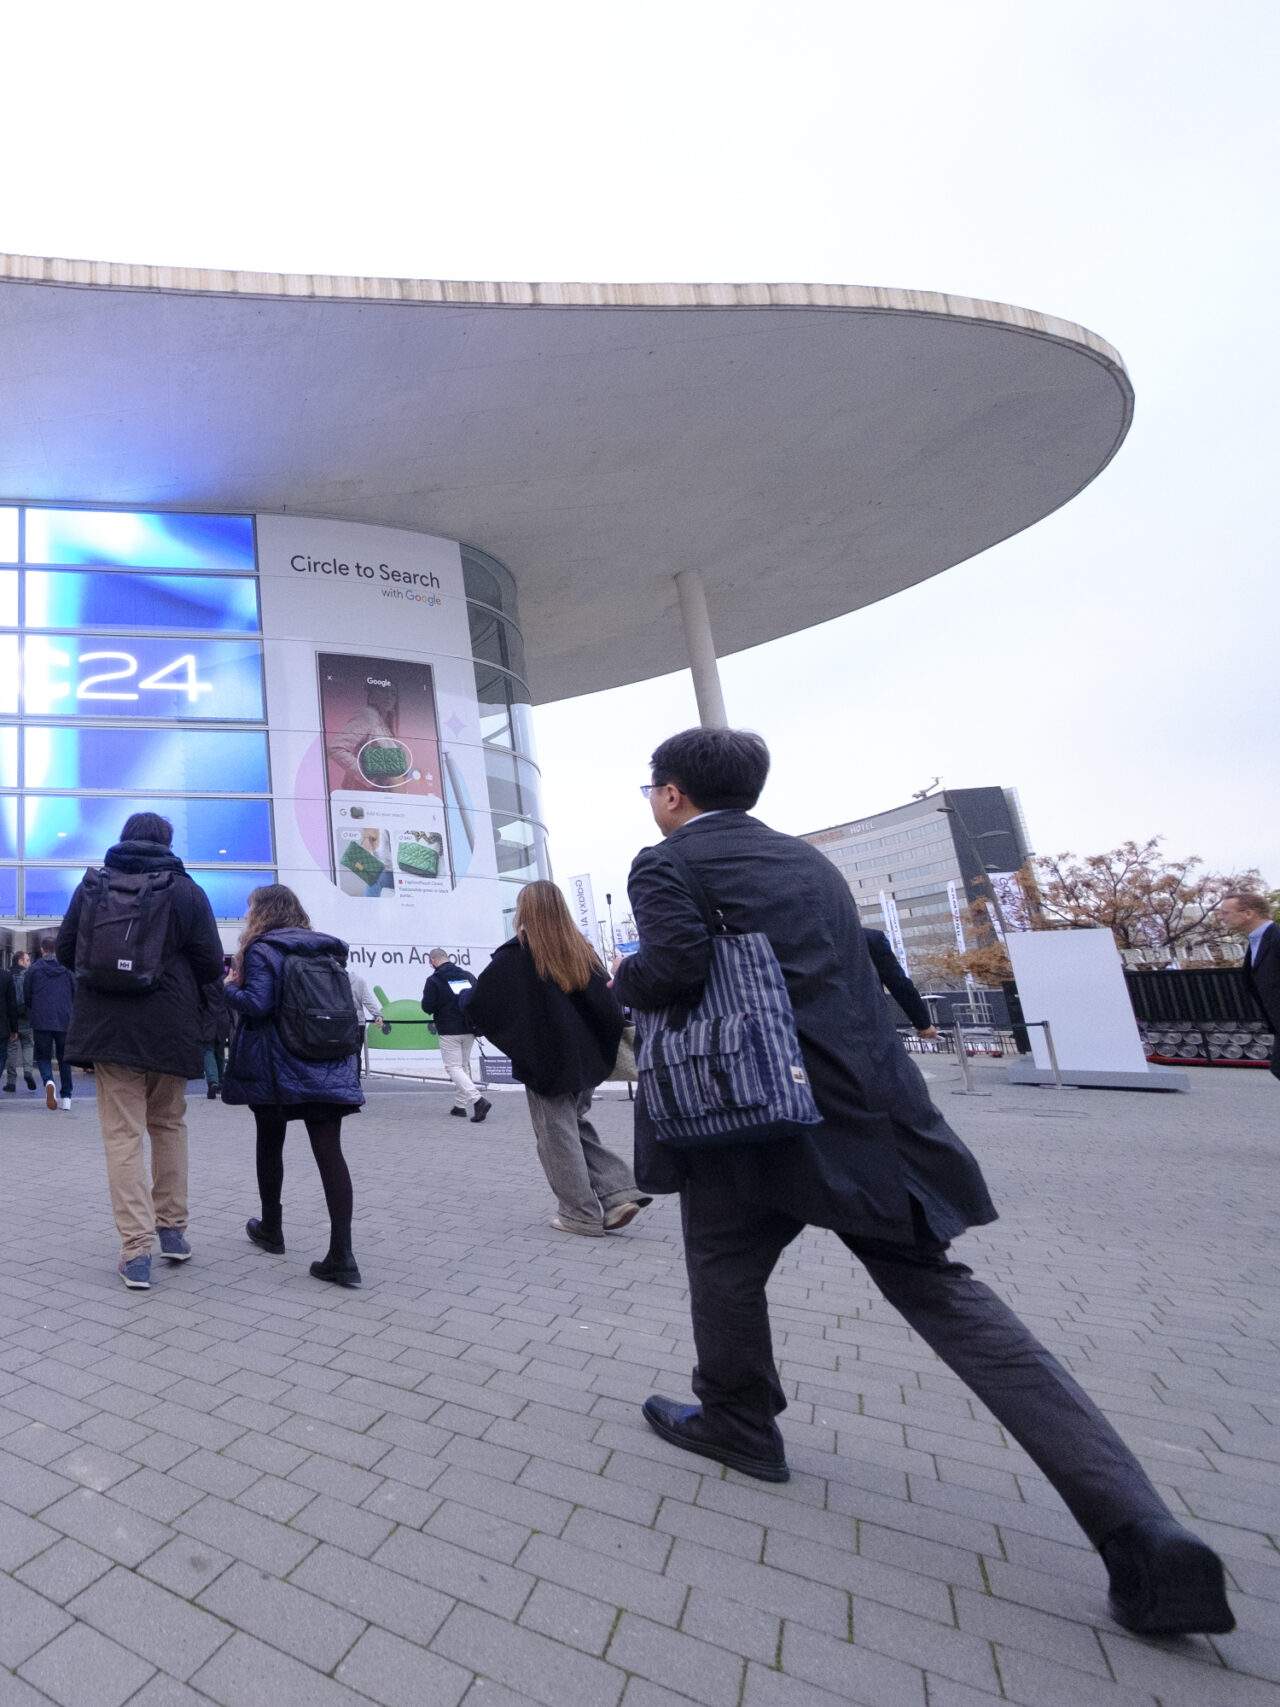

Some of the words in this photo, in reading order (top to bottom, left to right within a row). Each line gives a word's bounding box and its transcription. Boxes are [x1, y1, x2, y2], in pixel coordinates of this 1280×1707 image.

[290, 554, 350, 577] Circle
[355, 560, 375, 579] to
[379, 564, 441, 589] Search
[381, 587, 404, 600] with
[405, 590, 442, 607] Google
[366, 676, 392, 688] Google
[850, 821, 876, 834] HOTEL
[350, 947, 376, 968] nly
[382, 950, 404, 964] on
[409, 947, 471, 966] Anoid
